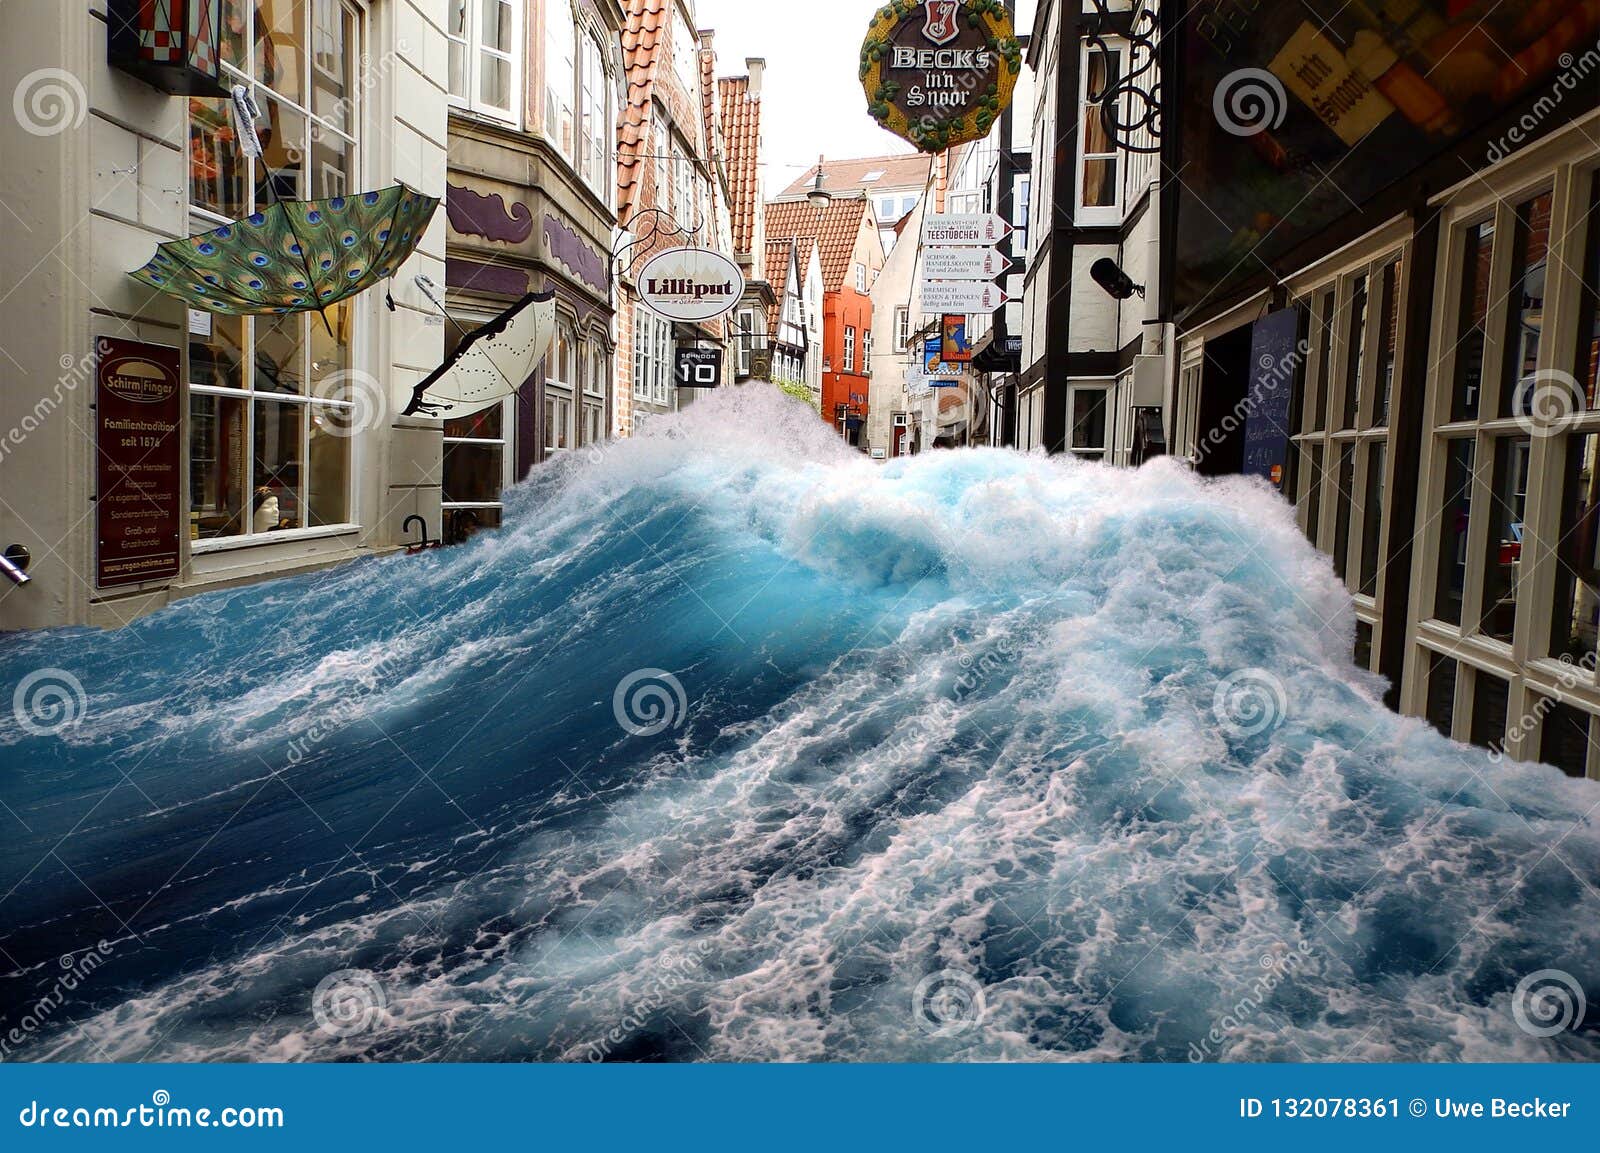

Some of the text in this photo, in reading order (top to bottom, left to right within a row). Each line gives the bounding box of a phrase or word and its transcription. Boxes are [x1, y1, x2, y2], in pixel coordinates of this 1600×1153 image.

[646, 278, 734, 299] Lilliput
[680, 364, 715, 383] 10
[107, 375, 172, 395] Schirm Finger
[104, 418, 176, 432] Familientradition
[121, 436, 137, 447] seit
